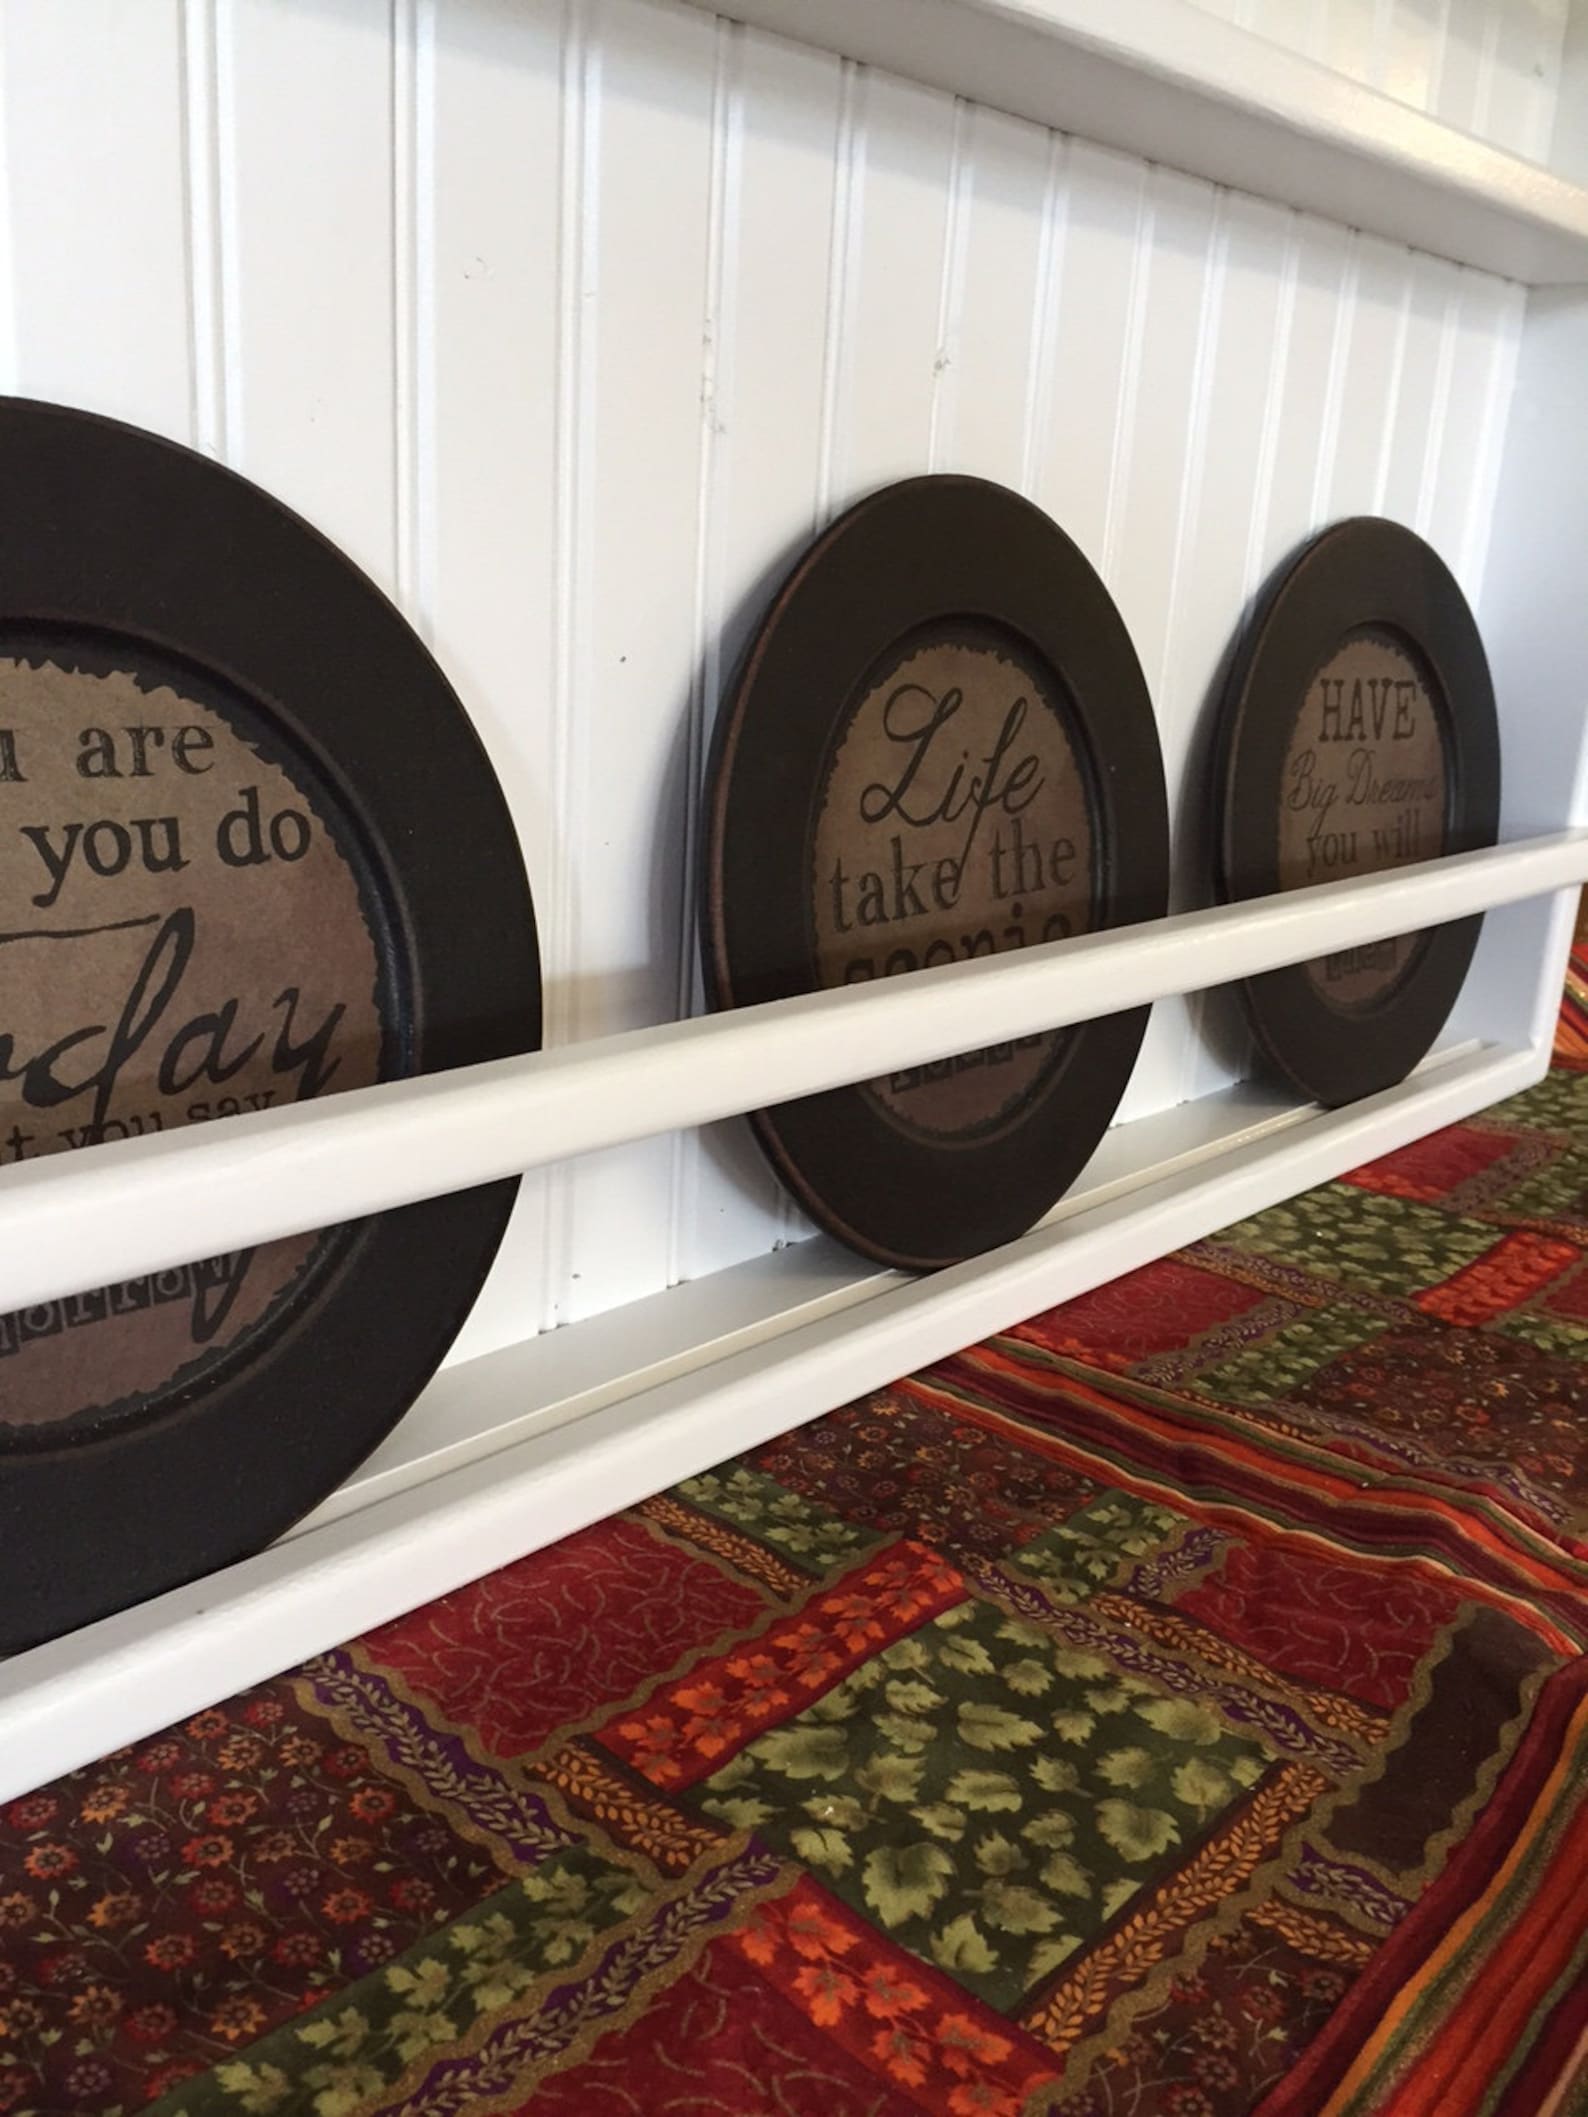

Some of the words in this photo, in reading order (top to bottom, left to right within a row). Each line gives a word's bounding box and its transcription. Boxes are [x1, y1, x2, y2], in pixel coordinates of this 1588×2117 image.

[76, 725, 215, 779] are
[1318, 677, 1417, 743] HAVE
[860, 684, 1046, 897] Life
[1288, 749, 1338, 838] Big
[20, 817, 191, 908] you
[216, 786, 311, 868] do
[828, 835, 962, 934] take
[989, 817, 1077, 900] the
[1306, 832, 1358, 878] you
[1372, 808, 1421, 861] will
